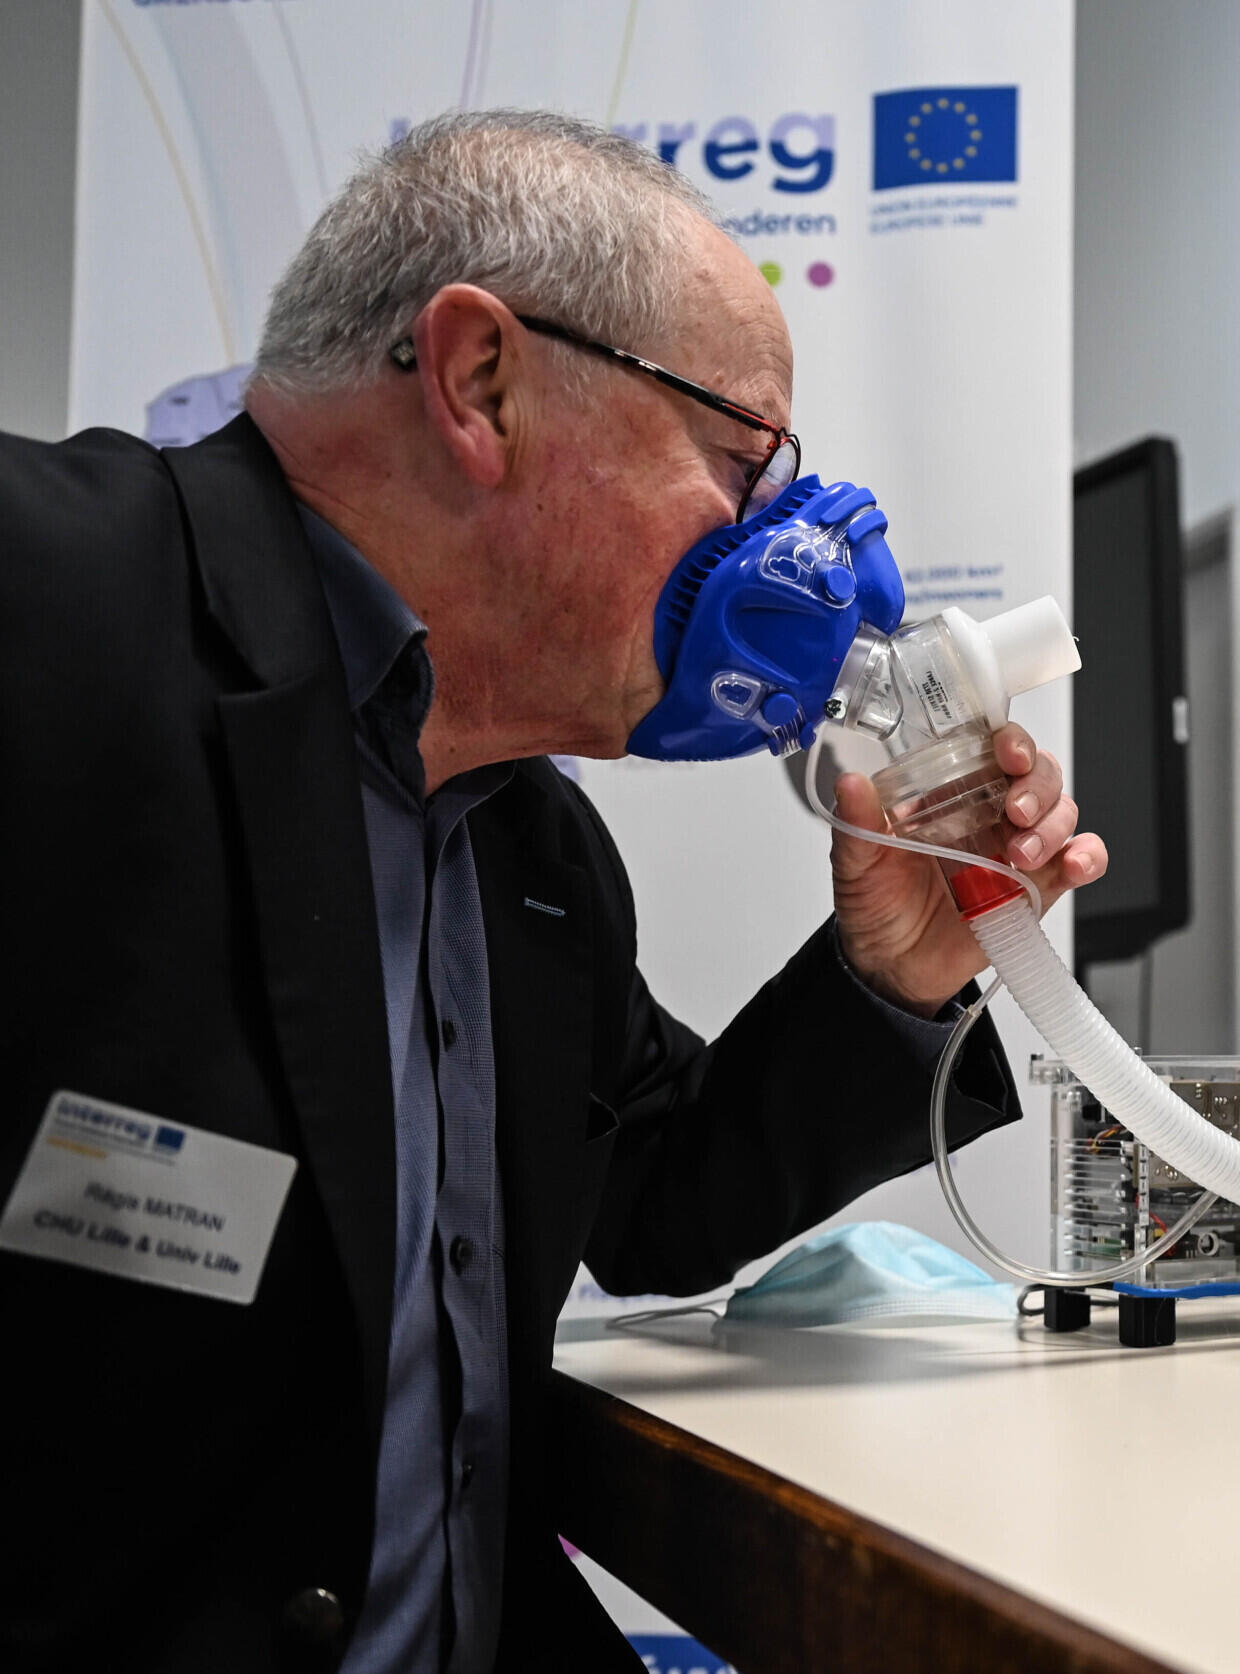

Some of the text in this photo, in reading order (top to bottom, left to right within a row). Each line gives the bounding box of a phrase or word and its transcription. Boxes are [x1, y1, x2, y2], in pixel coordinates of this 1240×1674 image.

[144, 1197, 225, 1232] MATRAN
[33, 1210, 241, 1275] CHU Lille & Univ Lille
